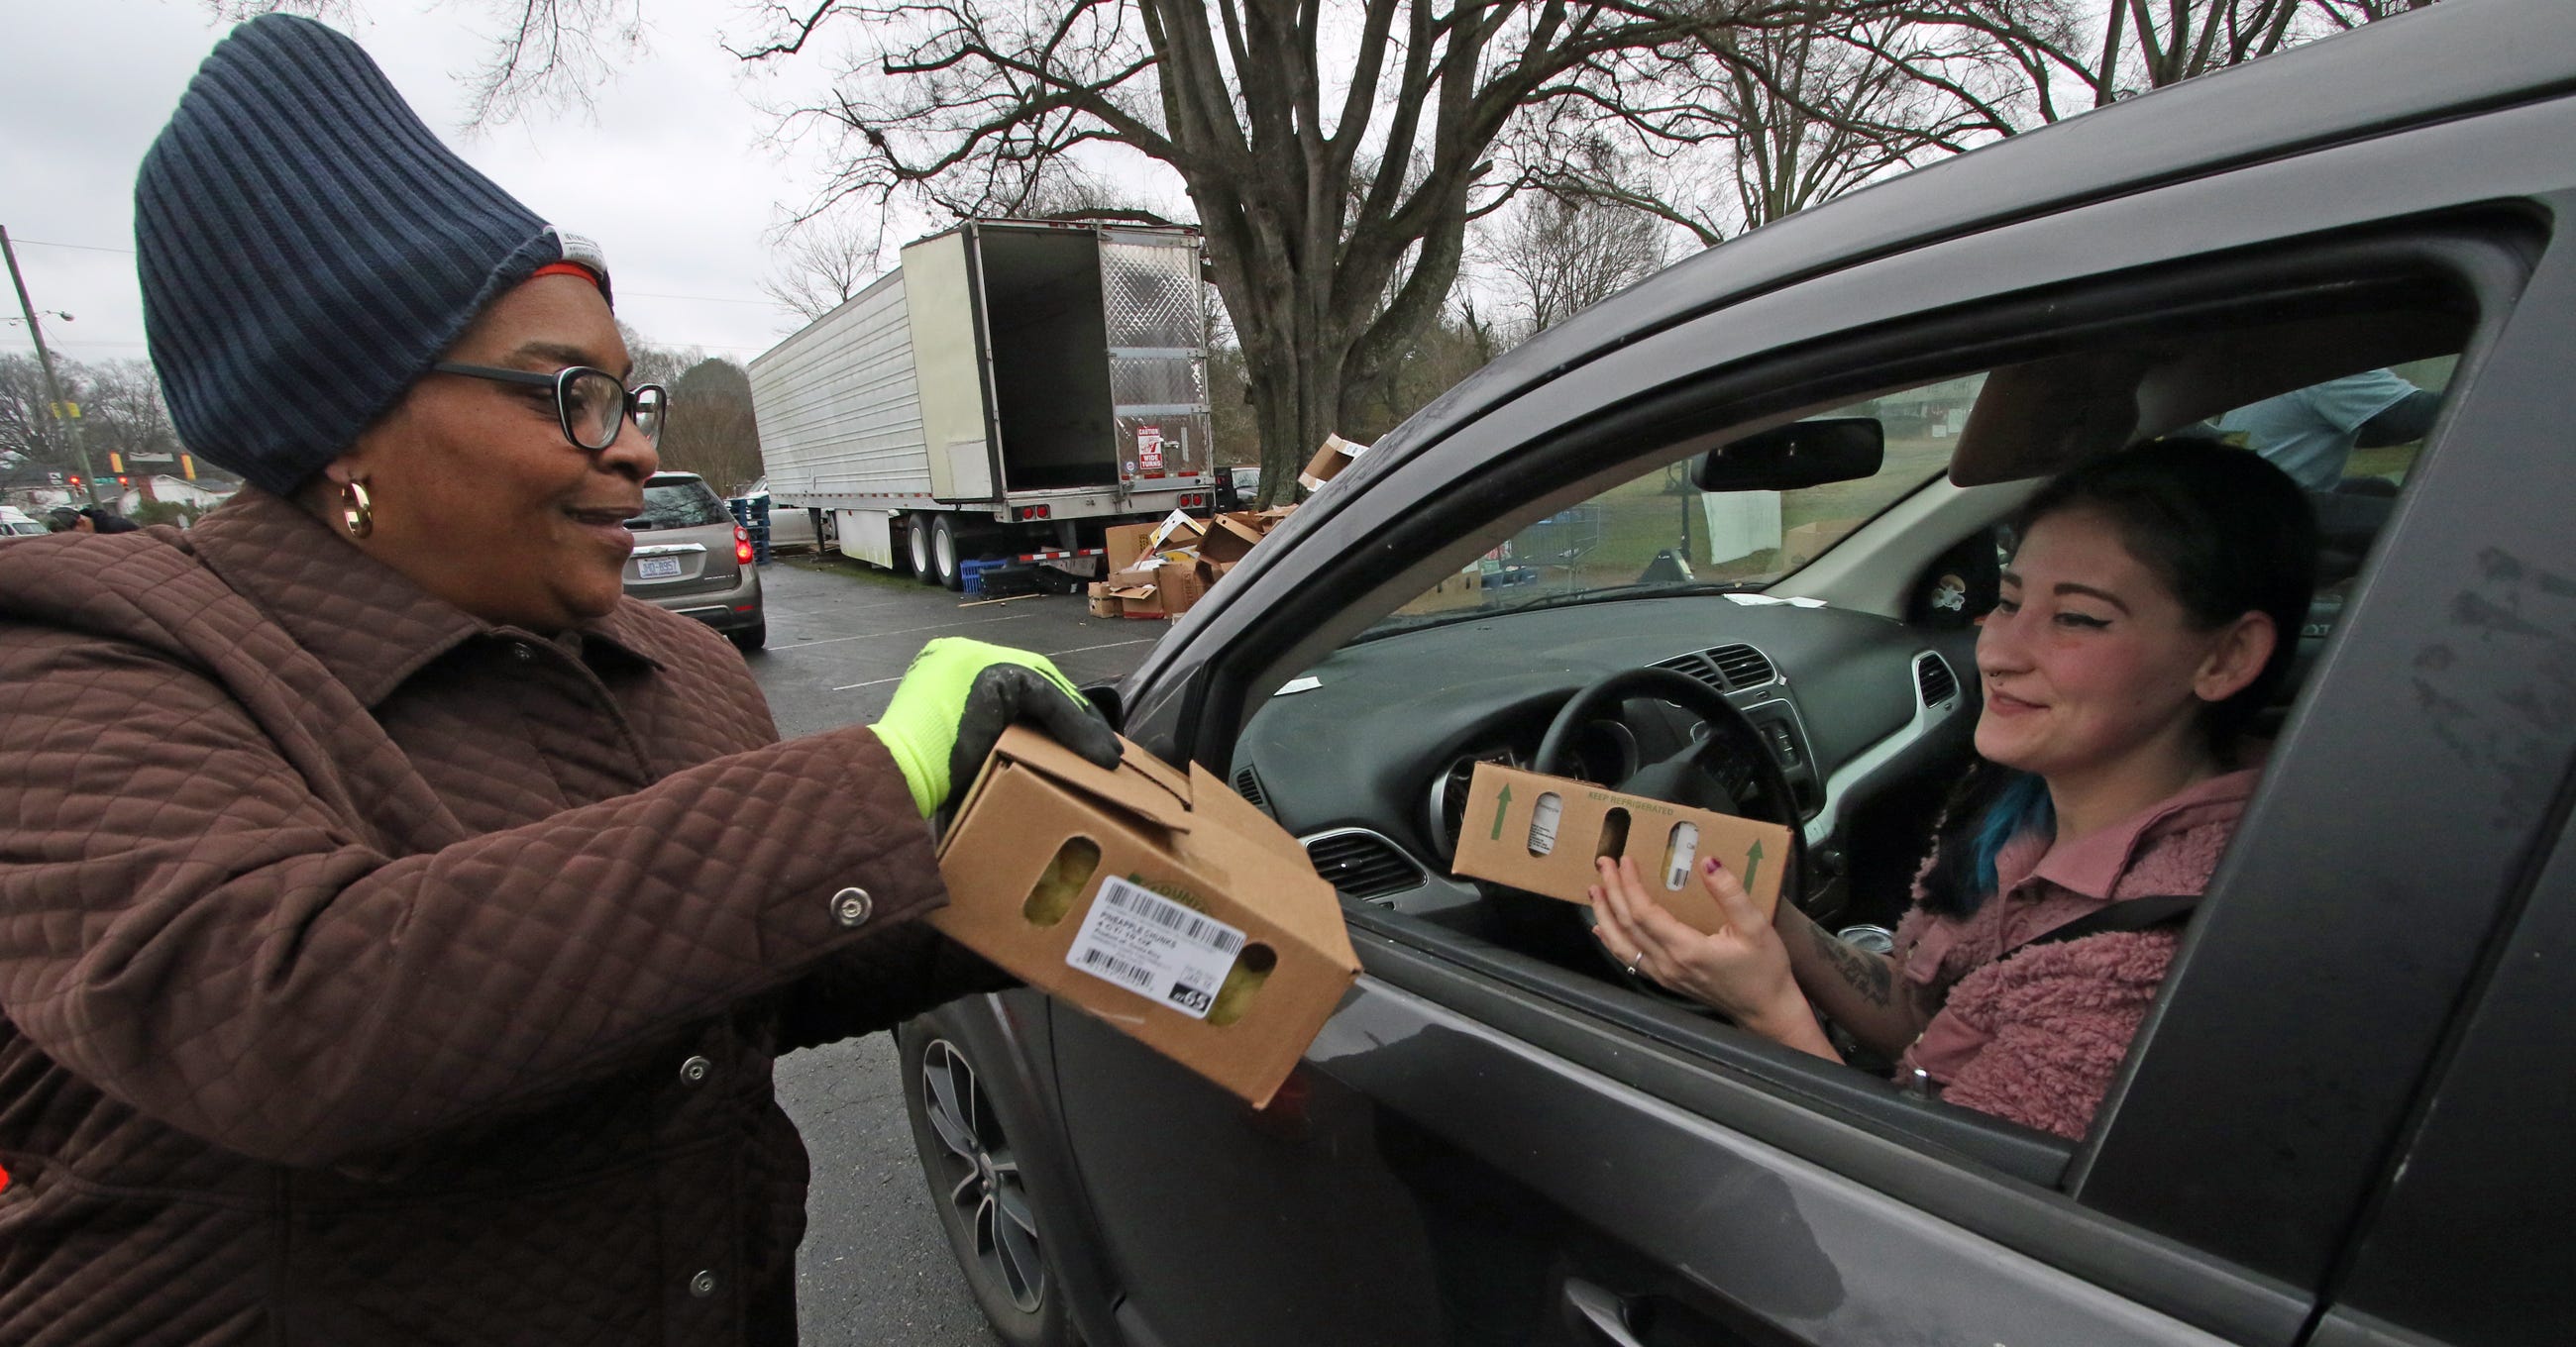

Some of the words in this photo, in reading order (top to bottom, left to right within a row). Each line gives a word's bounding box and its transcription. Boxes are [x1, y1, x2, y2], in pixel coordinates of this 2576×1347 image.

[1610, 795, 1673, 816] REFRIGERATED
[1100, 911, 1143, 934] PINEAPPLE
[1143, 929, 1177, 949] CHUNKS
